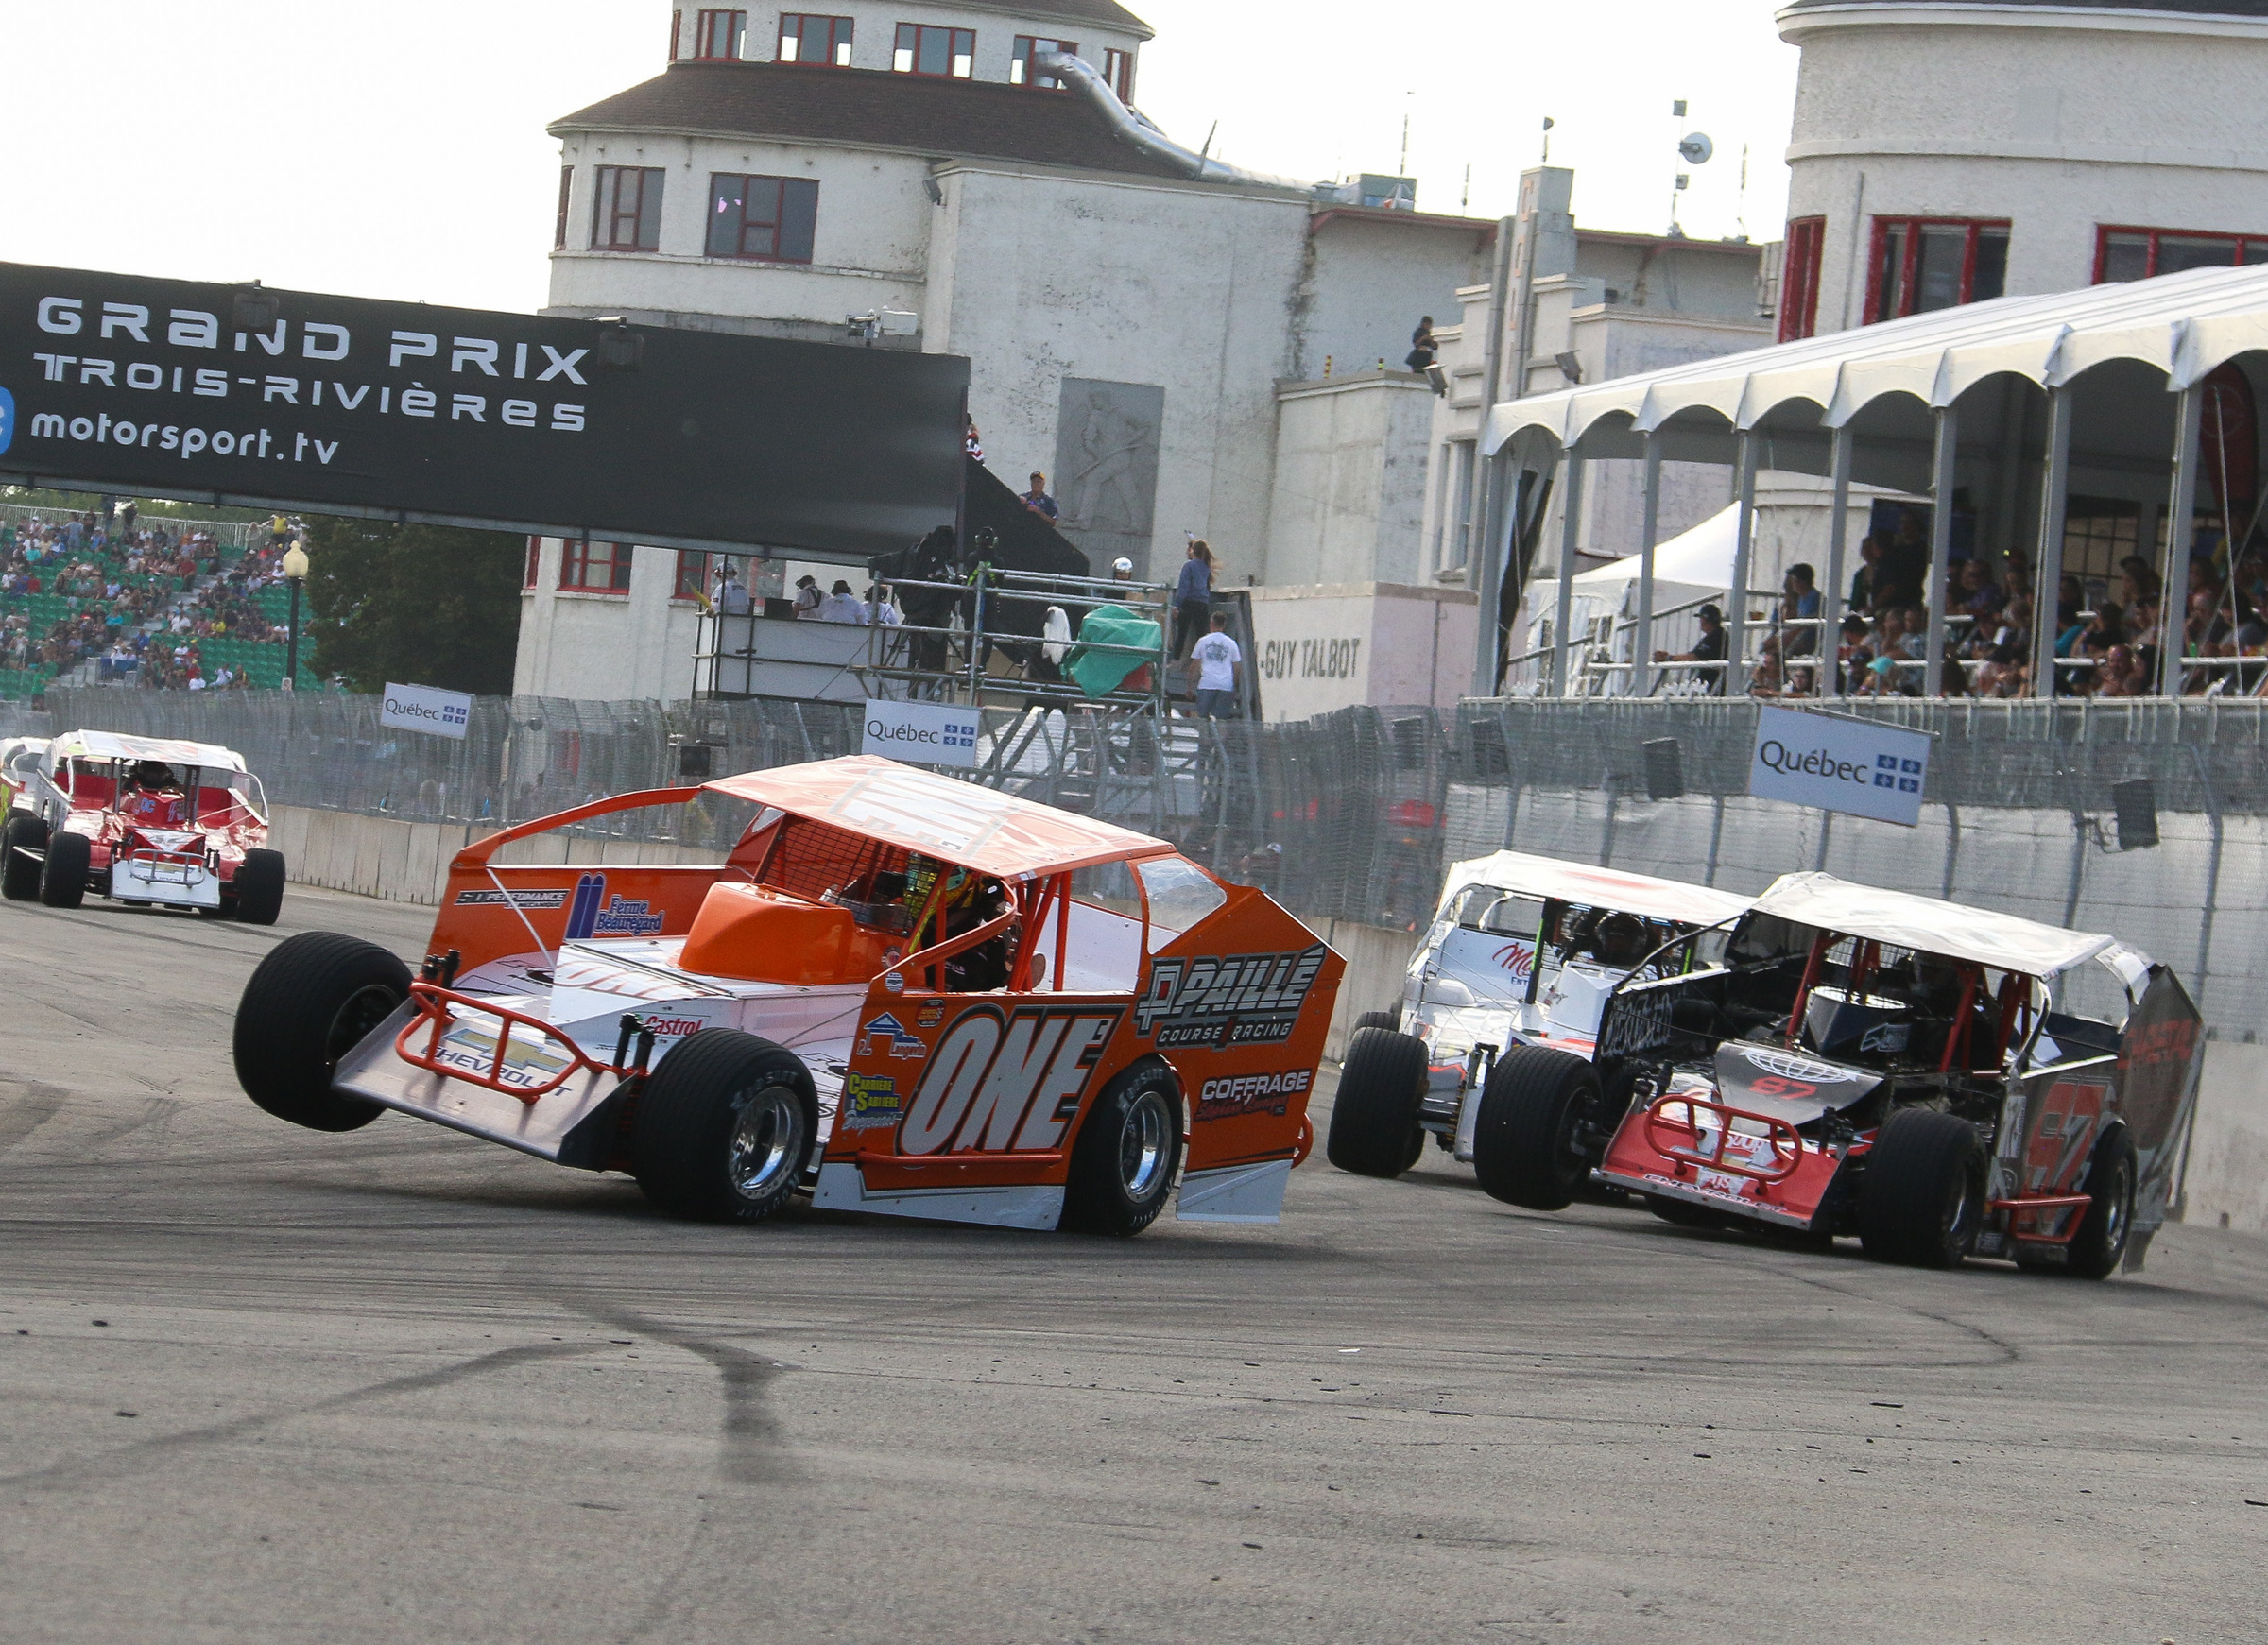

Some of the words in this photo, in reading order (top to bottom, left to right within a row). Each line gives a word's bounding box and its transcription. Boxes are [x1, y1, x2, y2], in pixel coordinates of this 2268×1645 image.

[389, 331, 591, 386] PRIX
[30, 412, 339, 465] motorsport.tv
[1302, 637, 1361, 679] TALBOT
[385, 698, 439, 721] Québec
[867, 720, 939, 745] Québec
[1761, 740, 1868, 785] Québec
[610, 896, 648, 916] Ferme
[595, 910, 664, 935] Beauregard
[1511, 976, 1530, 986] ENT
[645, 1015, 704, 1037] Castrol
[1158, 1026, 1225, 1043] COURSE
[1231, 1022, 1293, 1039] RACING
[900, 1009, 1123, 1156] ONE
[1201, 1071, 1311, 1102] COFFRAGE
[1748, 1076, 1818, 1101] 87
